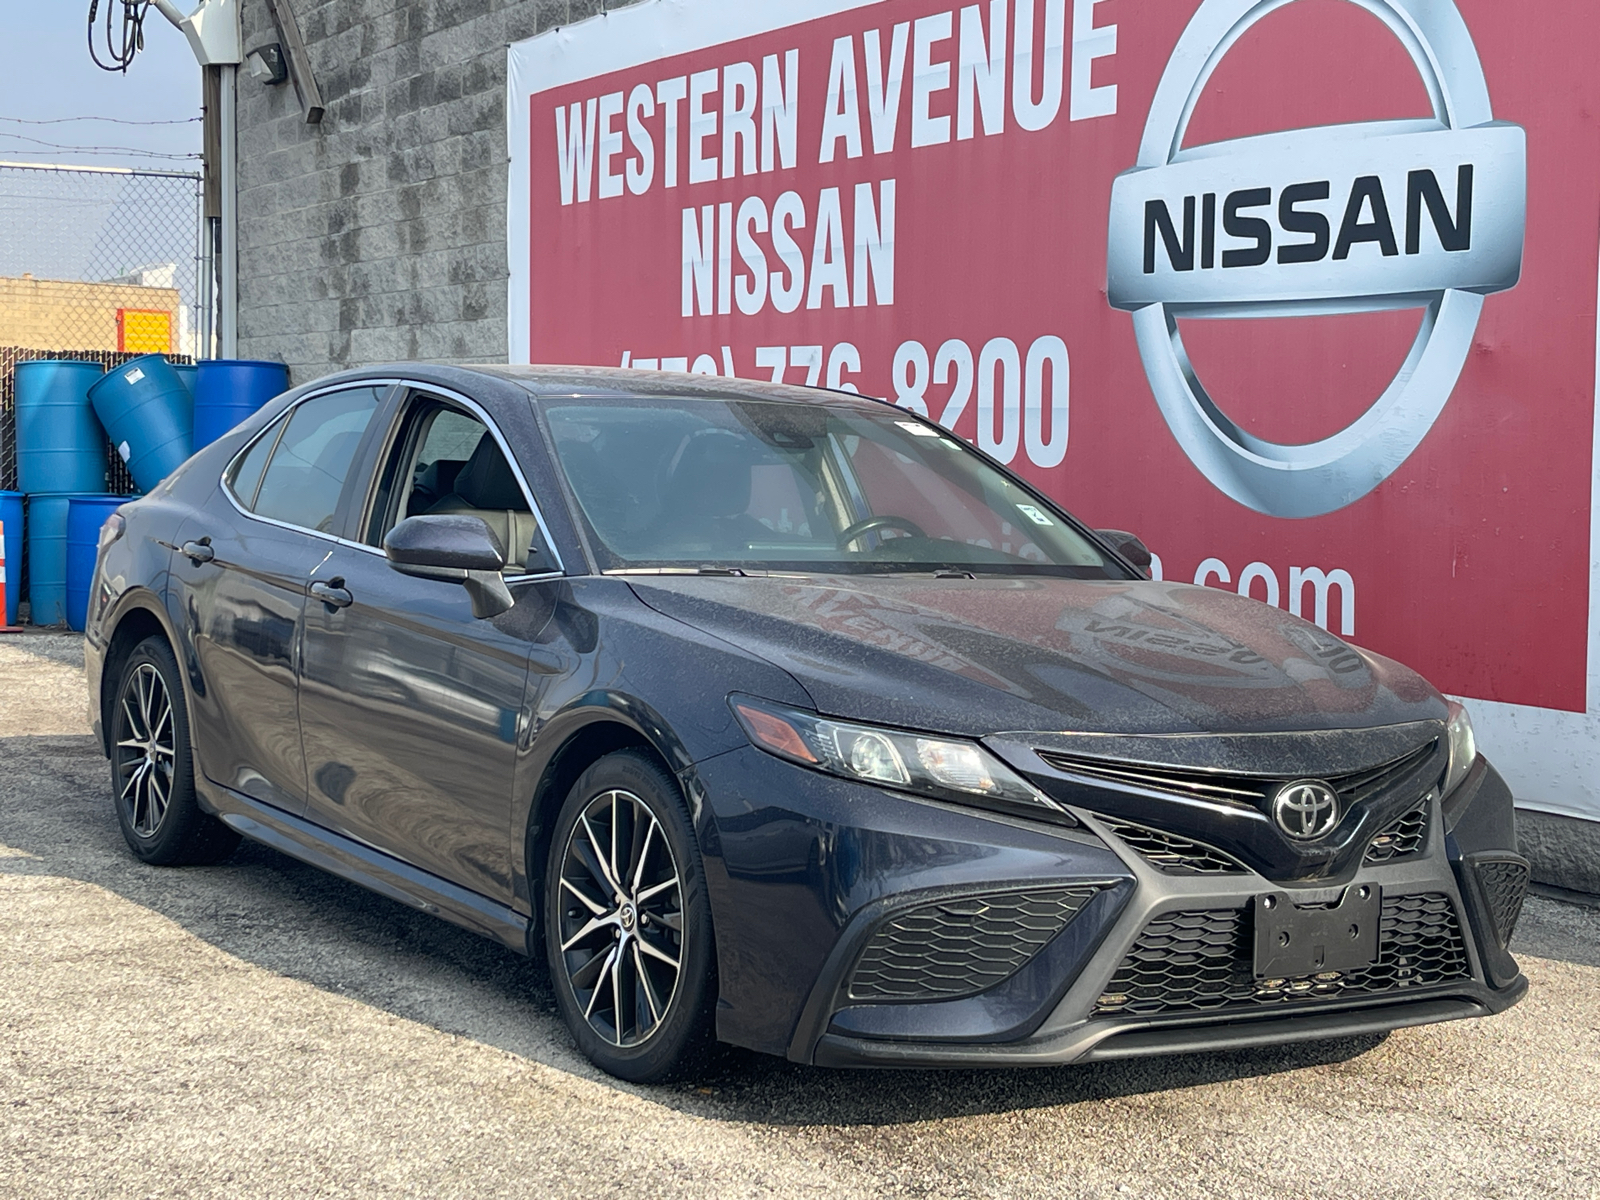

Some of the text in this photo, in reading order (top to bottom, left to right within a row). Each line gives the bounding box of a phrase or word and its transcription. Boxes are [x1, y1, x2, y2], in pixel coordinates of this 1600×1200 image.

[555, 0, 1118, 205] WESTERN AVENUE
[681, 179, 896, 317] NISSAN
[1143, 164, 1474, 274] NISSAN
[756, 335, 1070, 468] 8200
